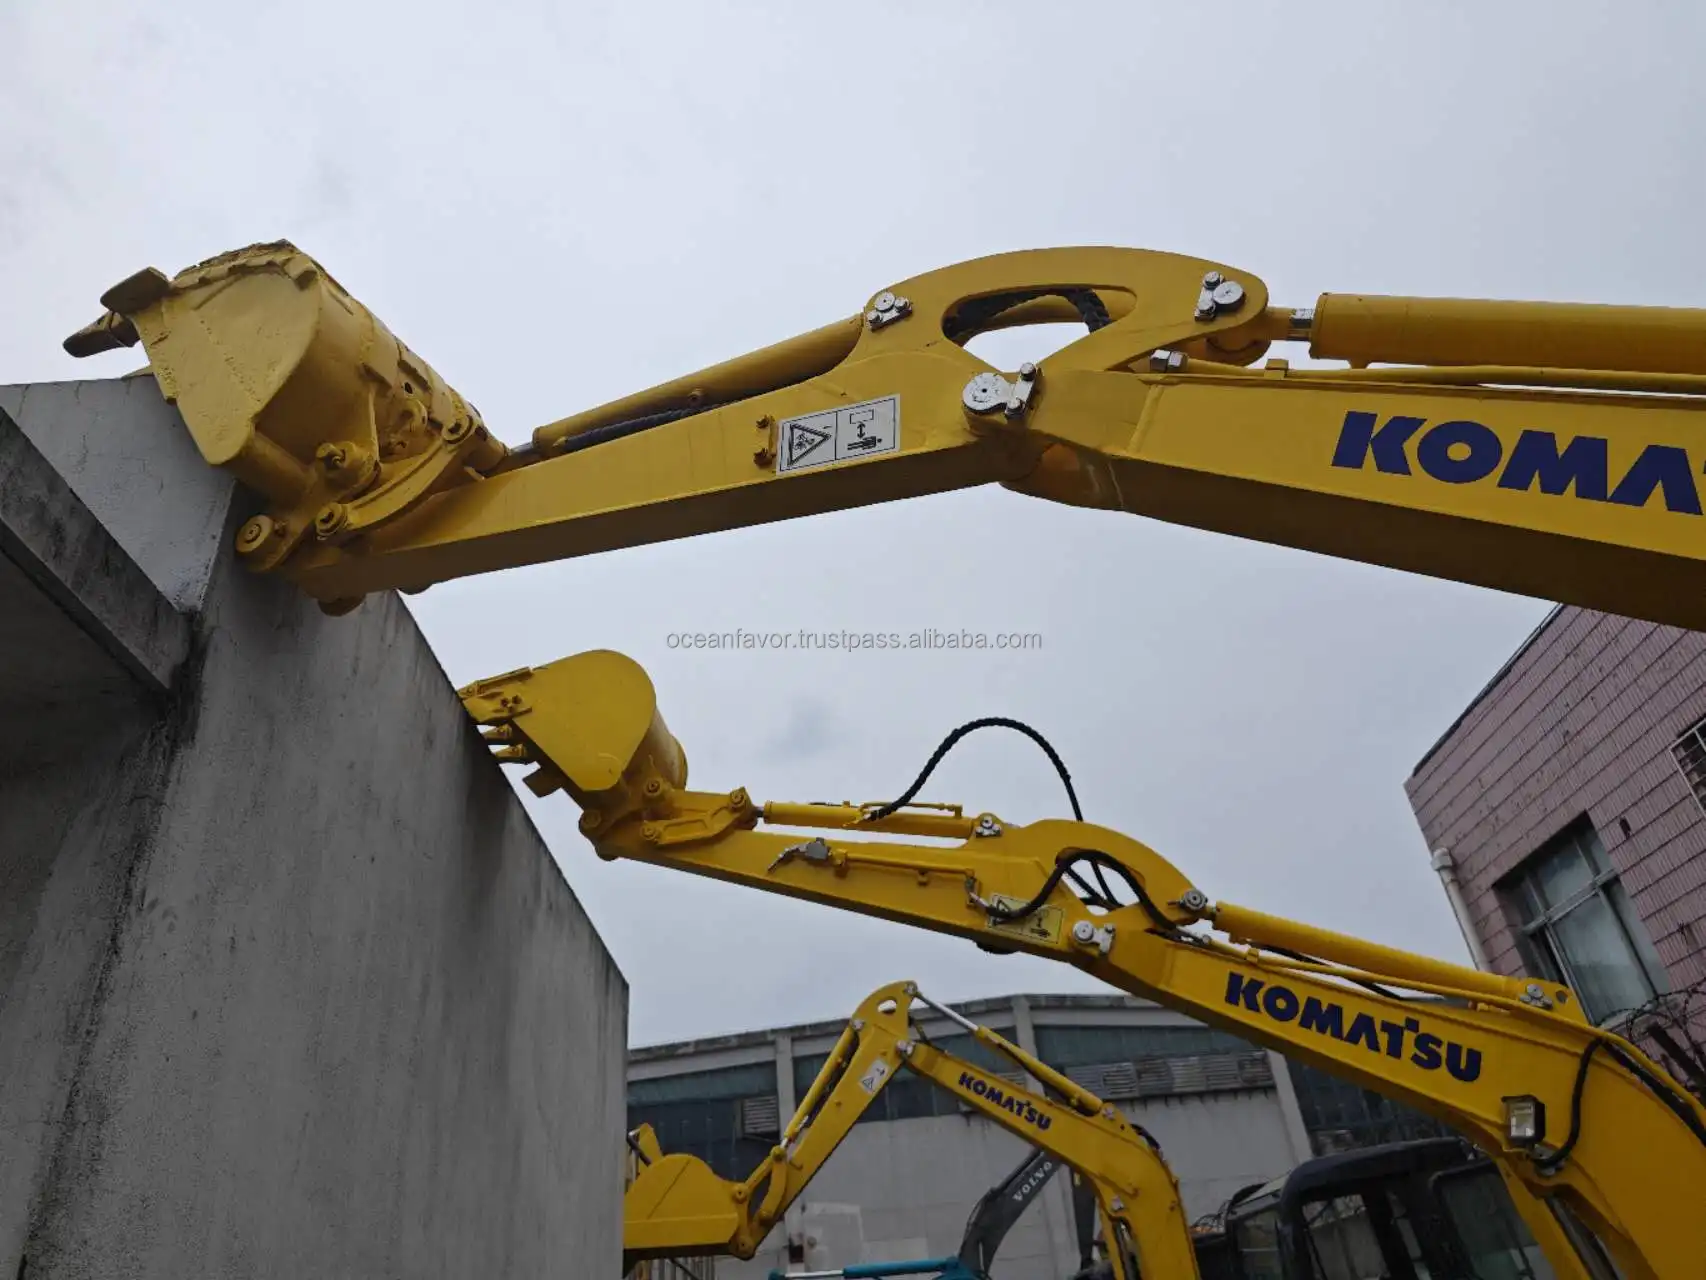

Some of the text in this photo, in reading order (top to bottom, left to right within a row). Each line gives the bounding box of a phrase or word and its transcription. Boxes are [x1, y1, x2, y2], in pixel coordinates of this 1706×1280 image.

[1331, 411, 1706, 515] KOMA
[1224, 971, 1482, 1082] KOMATSU
[958, 1072, 1052, 1130] KOMATSU
[1012, 1161, 1053, 1201] VOLVO
